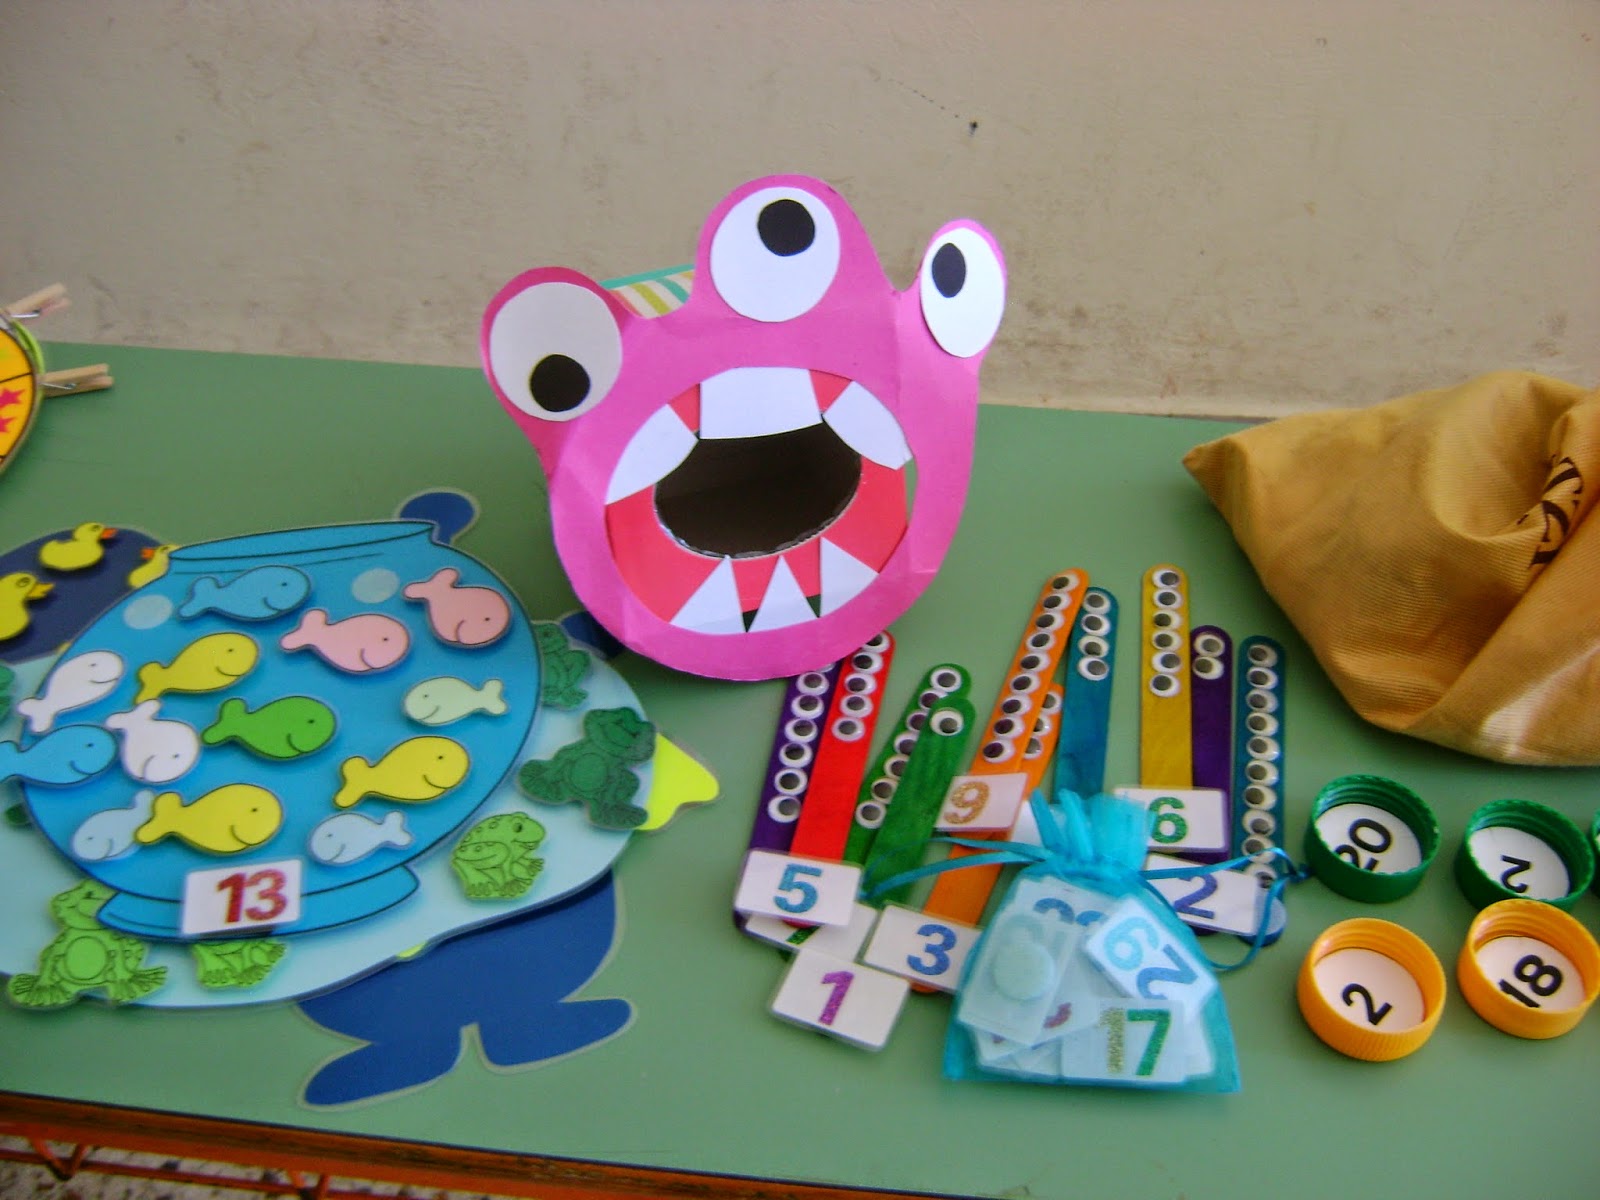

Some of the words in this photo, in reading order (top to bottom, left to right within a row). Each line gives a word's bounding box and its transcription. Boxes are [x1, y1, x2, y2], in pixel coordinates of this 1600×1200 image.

[945, 781, 991, 825] 9
[1149, 796, 1188, 844] 6
[1333, 818, 1392, 872] 20
[216, 868, 289, 924] 13
[773, 863, 823, 913] 5
[907, 924, 957, 976] 3
[818, 970, 855, 1026] 1
[1341, 982, 1393, 1025] 2
[1498, 954, 1564, 1009] 18
[1100, 1005, 1171, 1077] 17
